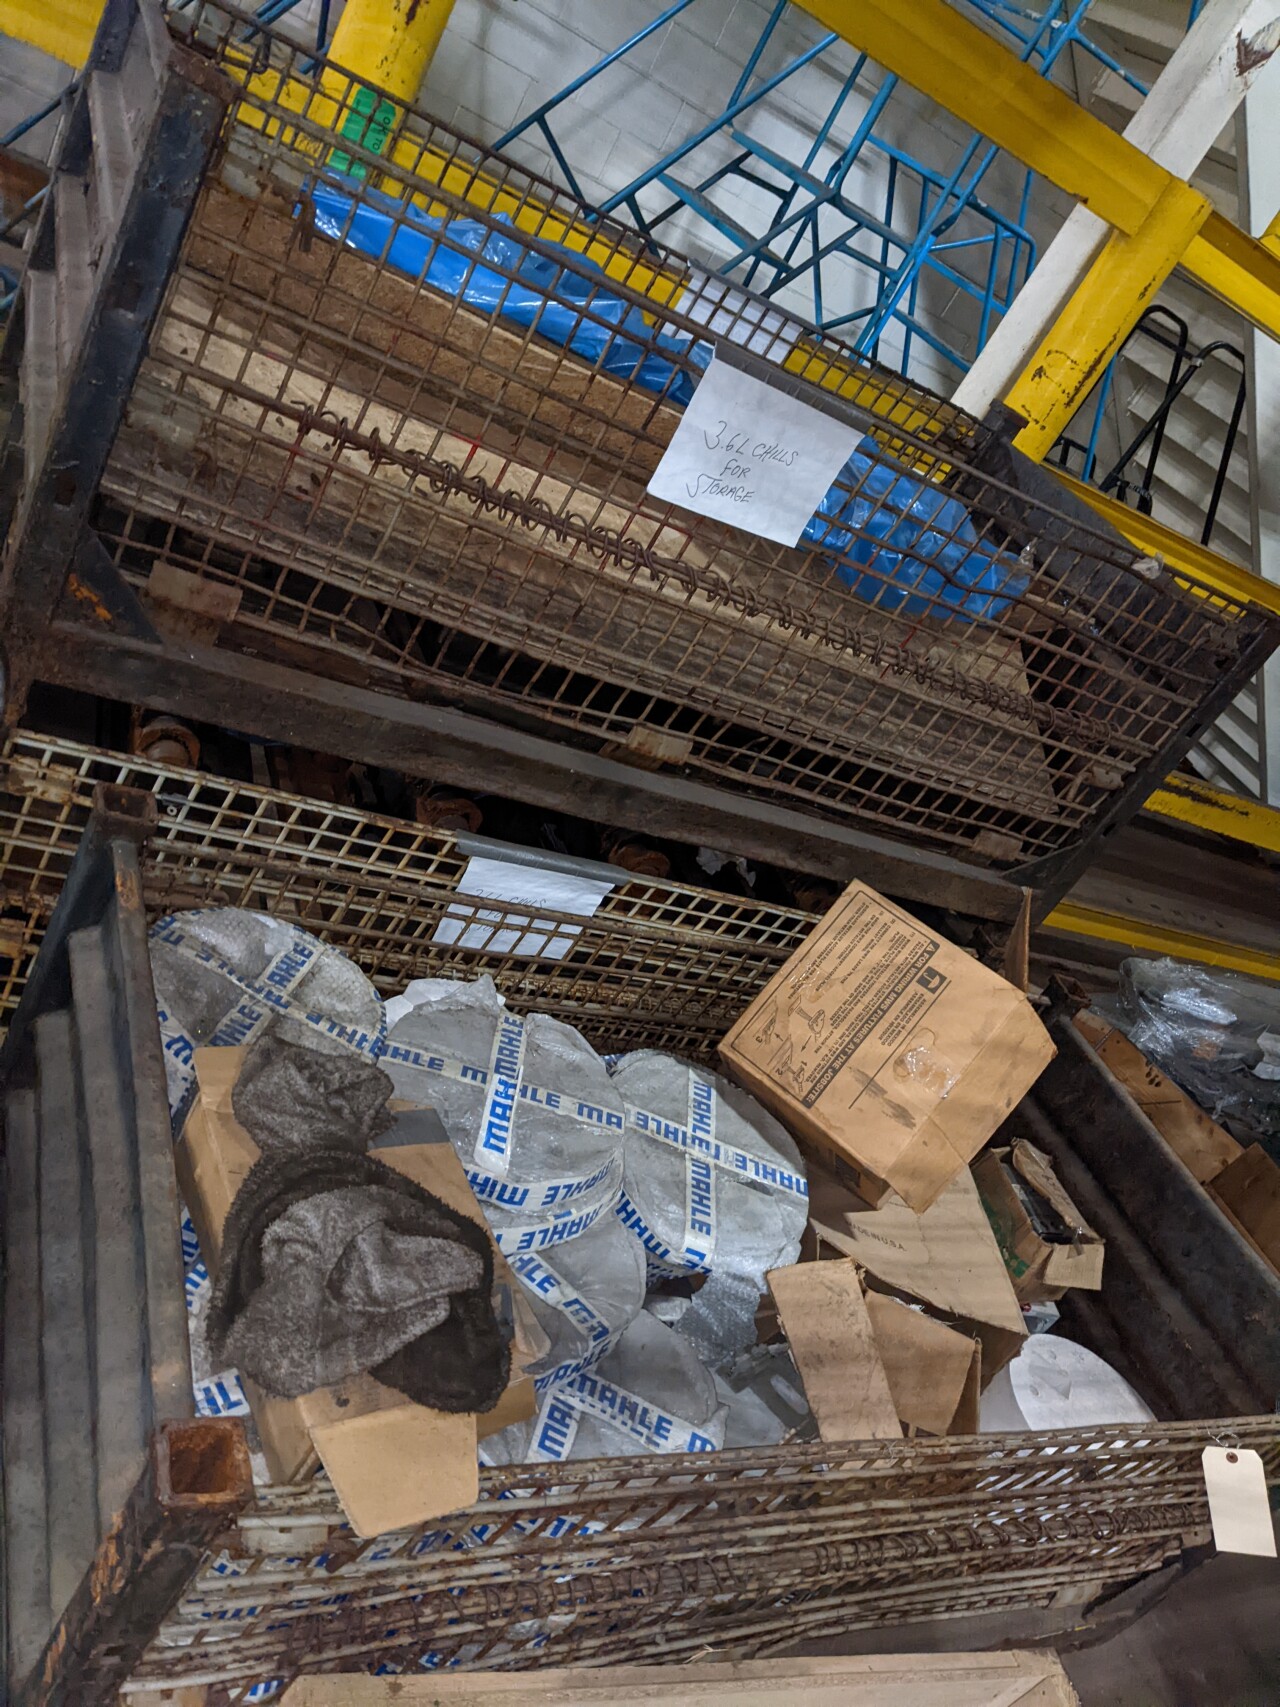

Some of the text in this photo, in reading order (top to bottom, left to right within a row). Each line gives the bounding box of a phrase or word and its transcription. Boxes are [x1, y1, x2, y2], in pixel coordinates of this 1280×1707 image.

[720, 459, 751, 478] FOR
[752, 443, 799, 466] CHILLS
[686, 474, 755, 502] STORAGE
[266, 942, 315, 989] AHLE
[493, 1015, 524, 1079] MAHLE
[754, 1035, 763, 1044] 3
[805, 951, 930, 1102] FOR WIRING MWS FIXTURES AT THE JOBSITE:
[774, 1067, 784, 1076] 2
[482, 1077, 517, 1154] MAH
[691, 1080, 712, 1152] MAHLE
[691, 1156, 712, 1237] MAHLE
[516, 1203, 604, 1251] MAHLE
[577, 1372, 674, 1441] MAHLE
